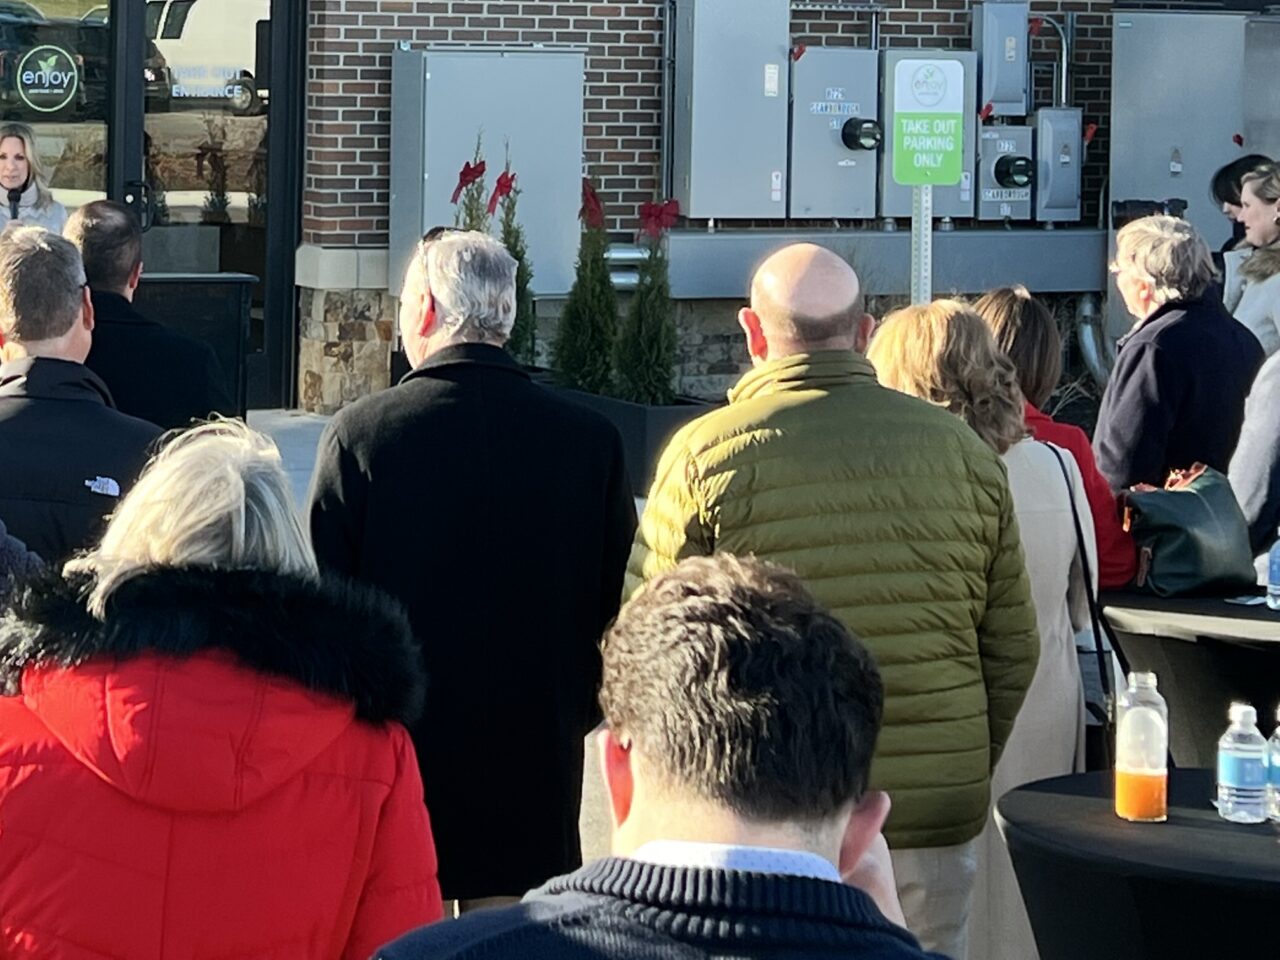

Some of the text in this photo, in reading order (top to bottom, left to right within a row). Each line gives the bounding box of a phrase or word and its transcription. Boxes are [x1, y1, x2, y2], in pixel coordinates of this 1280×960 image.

[22, 70, 72, 88] enjoy
[901, 119, 957, 133] TAKE OUT
[903, 136, 954, 151] PARKING
[913, 153, 944, 167] ONLY
